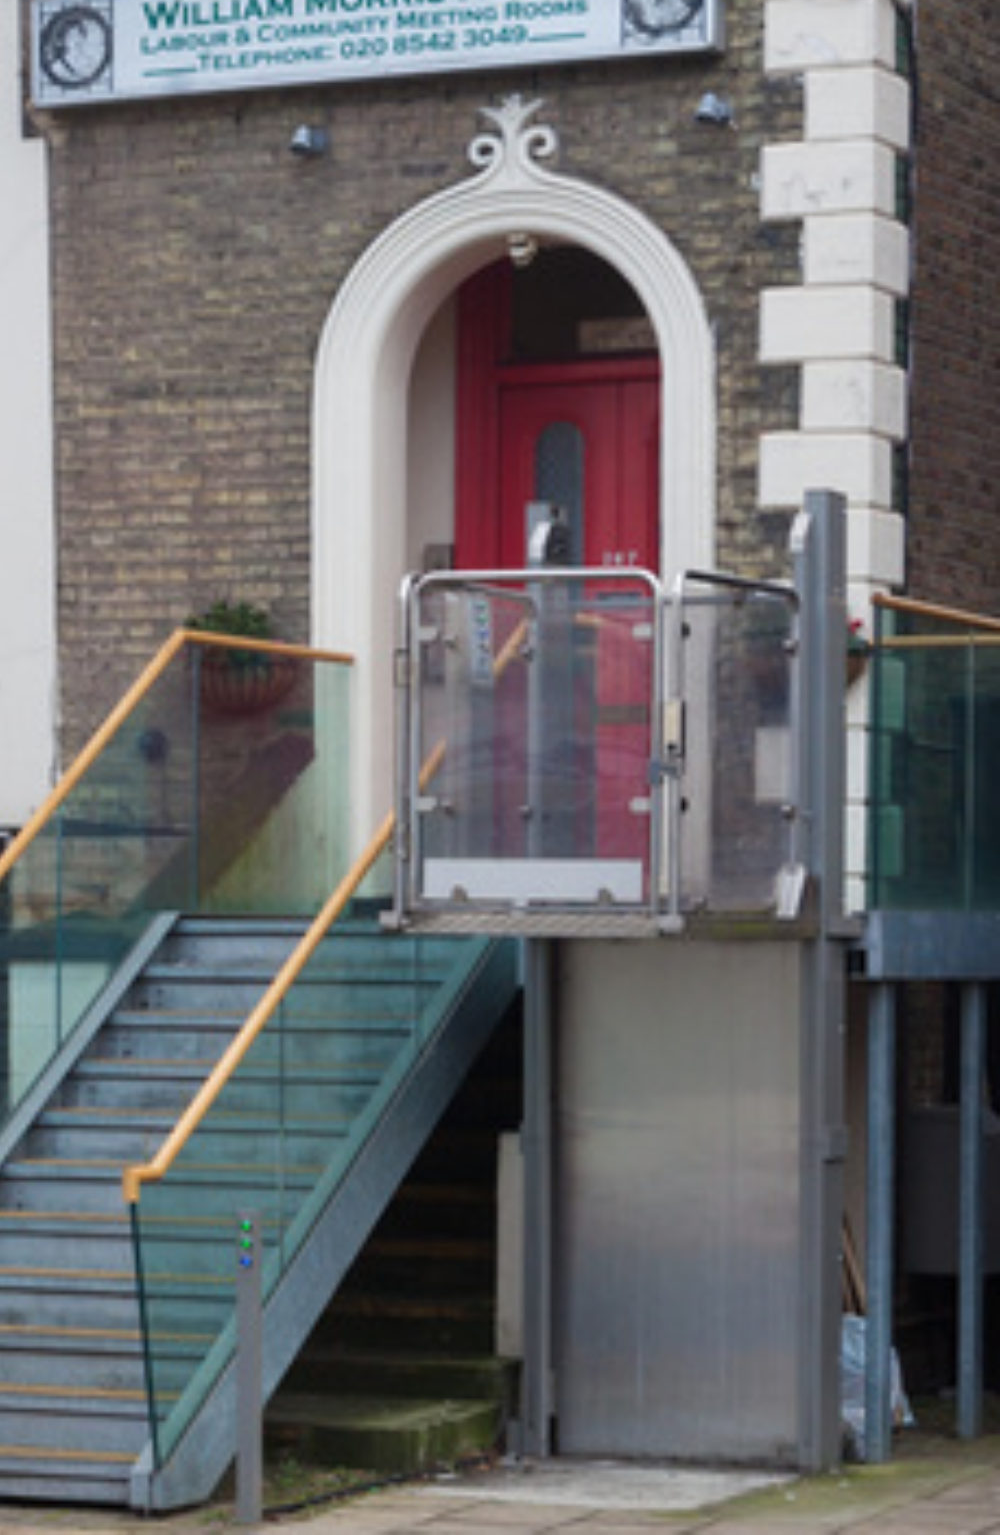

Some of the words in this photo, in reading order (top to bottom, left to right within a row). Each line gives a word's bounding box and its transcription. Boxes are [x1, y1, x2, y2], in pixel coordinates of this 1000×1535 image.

[140, 29, 228, 55] LABOUR
[234, 26, 250, 46] &
[256, 16, 389, 43] COMMUNITY
[396, 7, 498, 29] MEETING
[197, 44, 333, 70] TELEPHONE:
[340, 37, 388, 59] 020
[392, 31, 456, 54] 8542
[463, 24, 529, 48] 3049
